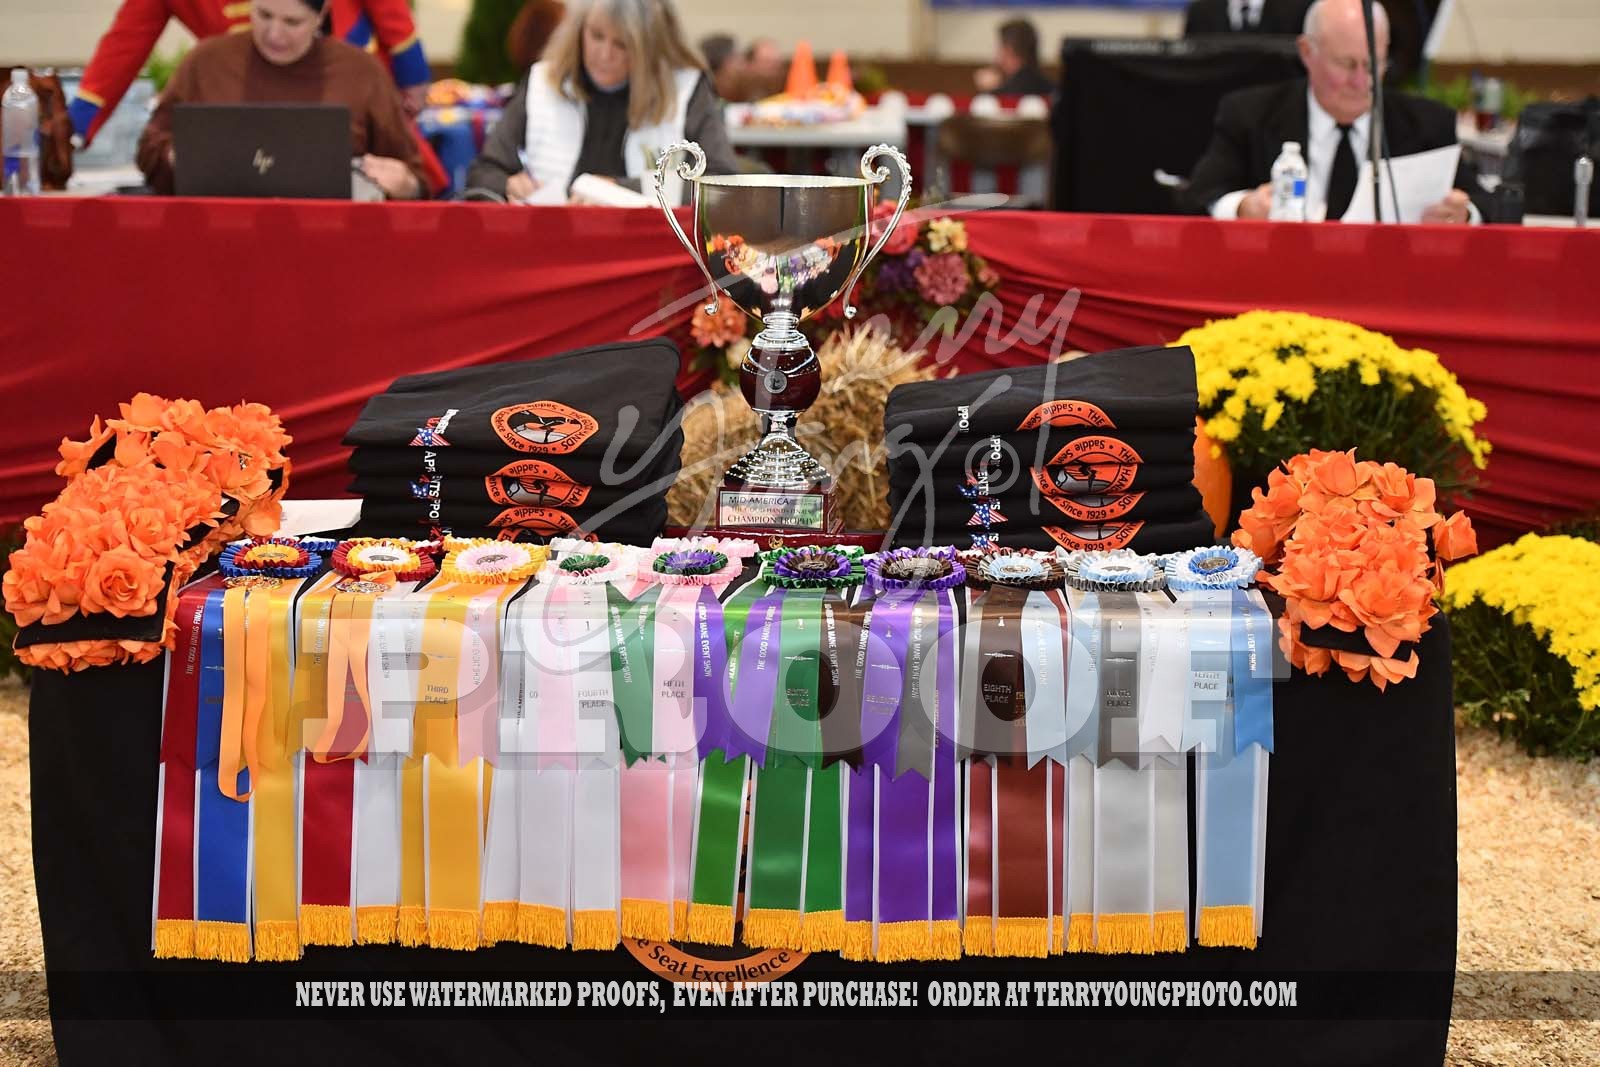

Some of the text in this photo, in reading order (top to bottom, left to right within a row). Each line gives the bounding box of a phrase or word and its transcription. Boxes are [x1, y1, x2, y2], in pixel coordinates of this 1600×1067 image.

[1043, 403, 1073, 415] Saddle
[1088, 408, 1105, 426] THE
[503, 432, 525, 449] Since
[528, 444, 549, 454] 1929
[1074, 439, 1105, 451] Saddle
[509, 463, 540, 475] Saddle
[728, 496, 790, 505] MID-AMERICA
[513, 508, 545, 518] Saddle
[1059, 500, 1107, 519] Since 1929
[727, 514, 814, 525] CHAMPION TROPHY
[1057, 533, 1105, 553] Since 1929
[193, 604, 204, 625] FINALS
[190, 626, 200, 645] HANDS
[614, 628, 625, 646] MANE
[699, 622, 709, 639] MANE
[761, 621, 772, 641] HANDS
[828, 631, 837, 649] MANE
[858, 629, 869, 650] HANDS
[618, 646, 629, 665] EVENT
[701, 640, 711, 659] EVENT
[759, 641, 768, 658] GOOD
[912, 643, 921, 661] MANE
[757, 659, 766, 671] THE
[829, 649, 839, 668] EVENT
[856, 650, 865, 667] GOOD
[1248, 652, 1257, 672] SHOW
[186, 664, 194, 675] THE
[622, 666, 633, 684] SHOW
[703, 660, 713, 677] SHOW
[831, 668, 840, 686] SHOW
[911, 661, 921, 680] EVENT
[426, 684, 449, 694] THIRD
[663, 680, 685, 688] FIFTH
[983, 684, 1012, 694] EIGHTH
[1193, 682, 1218, 690] PLACE
[424, 695, 449, 705] PLACE
[577, 689, 609, 698] FOURTH
[661, 690, 686, 698] PLACE
[984, 695, 1009, 704] PLACE
[581, 701, 607, 709] PLACE
[1106, 699, 1132, 707] PLACE
[648, 945, 791, 984] Seat Excellence
